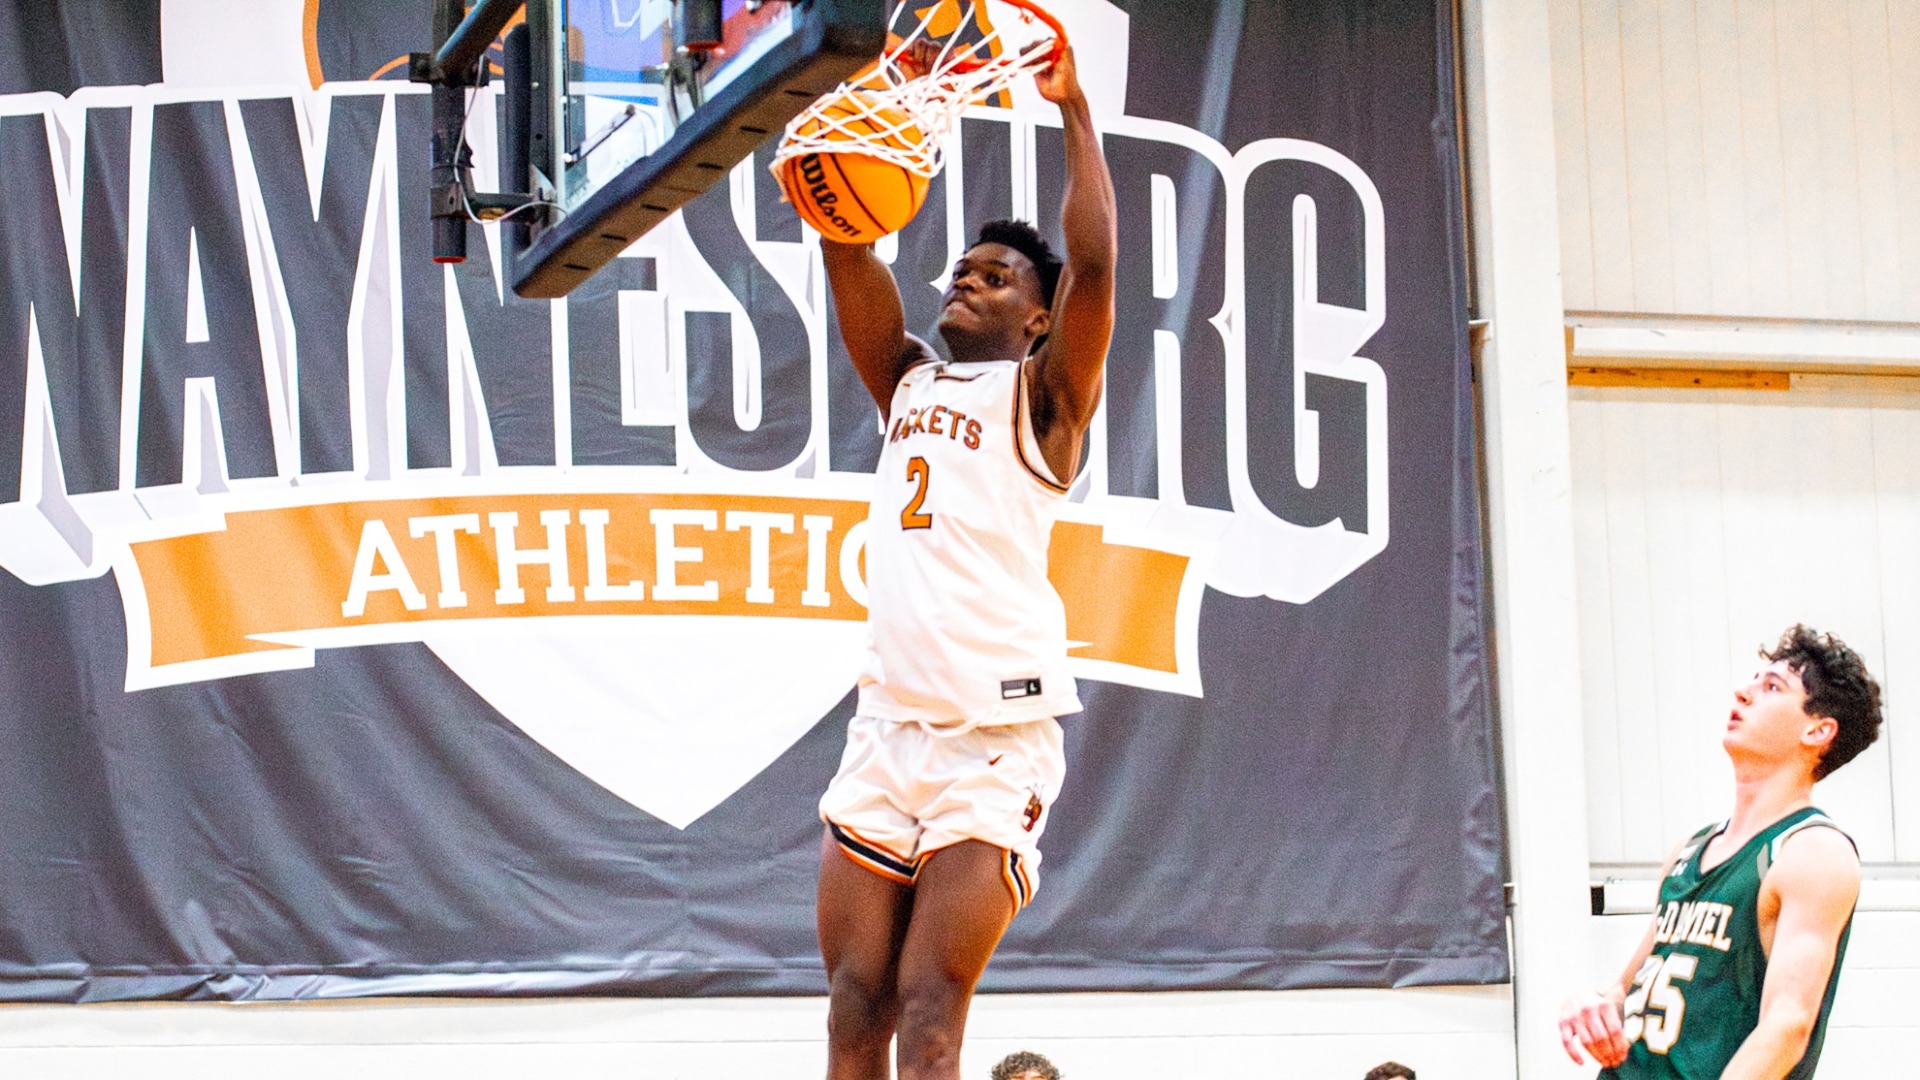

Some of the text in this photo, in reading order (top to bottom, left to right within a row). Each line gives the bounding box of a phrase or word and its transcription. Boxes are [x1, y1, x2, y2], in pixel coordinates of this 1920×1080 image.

[801, 150, 862, 237] Wilson
[901, 456, 932, 531] 2
[1622, 953, 1699, 1055] 25
